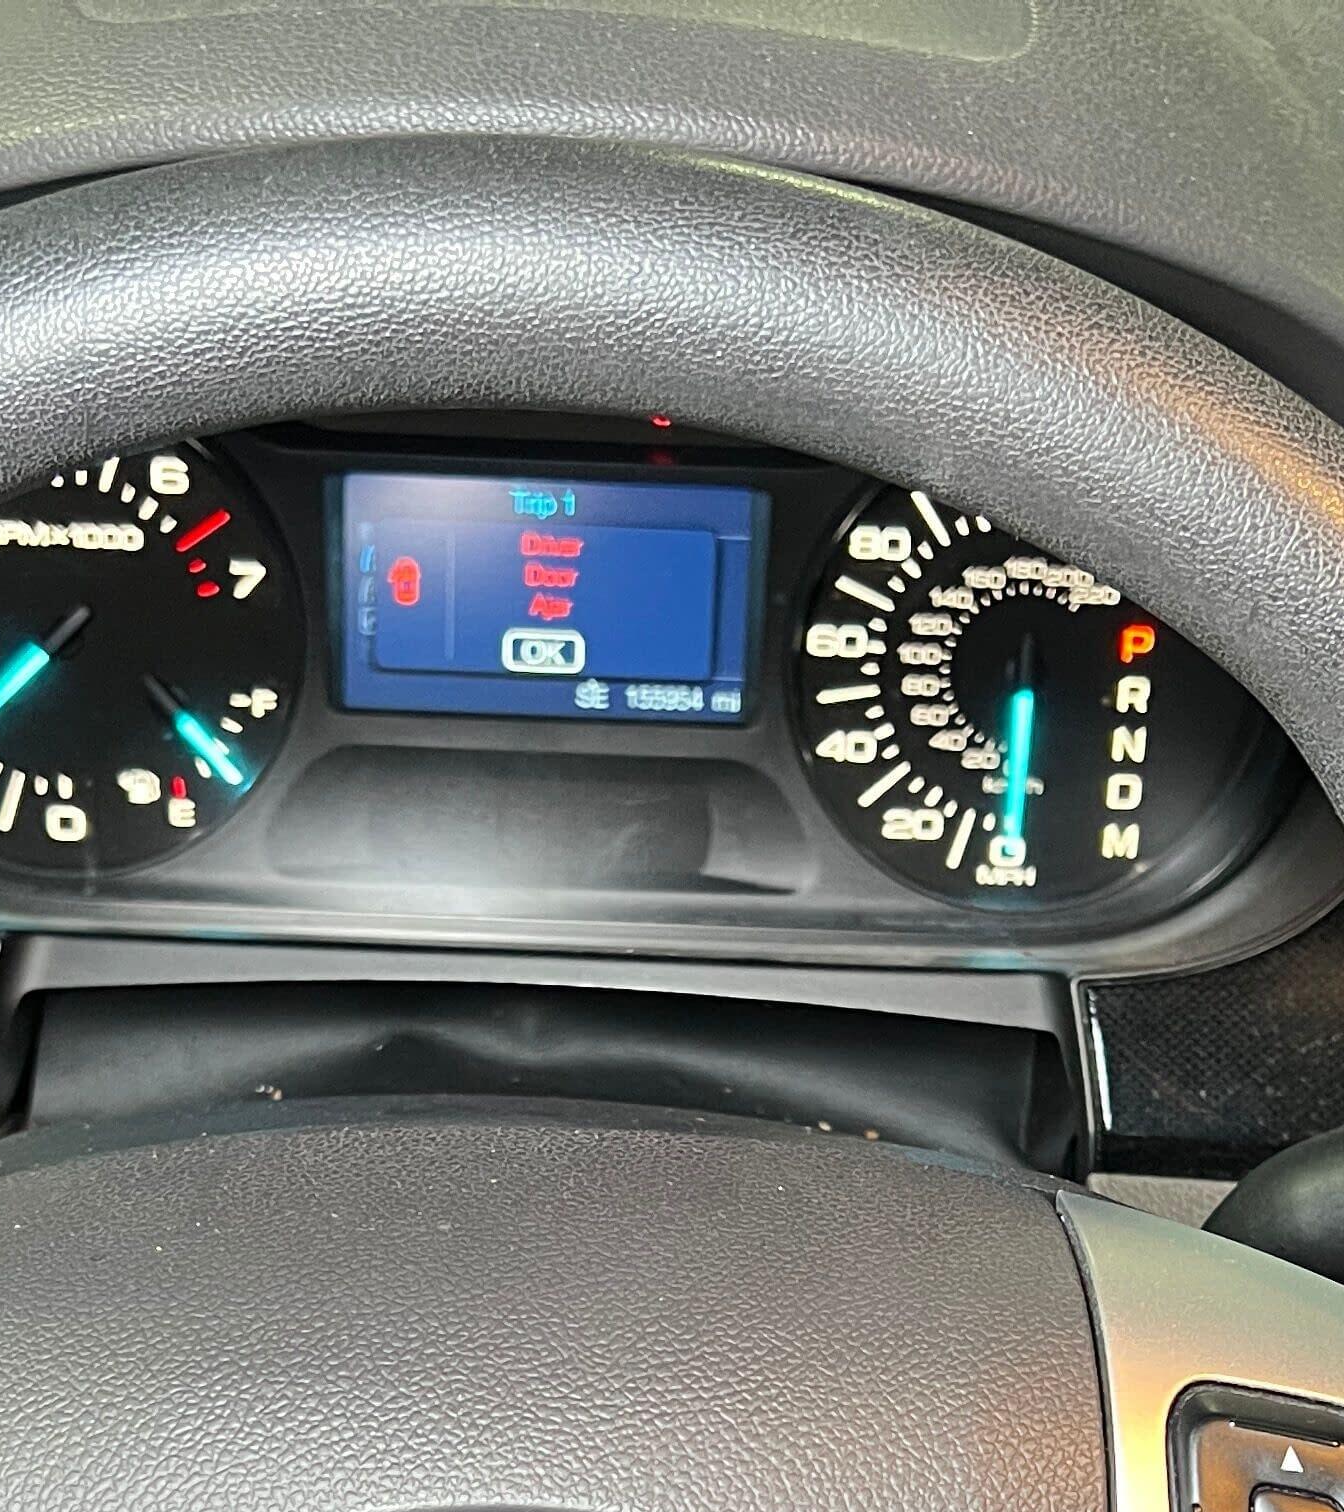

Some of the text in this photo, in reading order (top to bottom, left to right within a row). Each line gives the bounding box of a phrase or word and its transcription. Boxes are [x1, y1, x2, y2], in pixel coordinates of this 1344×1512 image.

[150, 455, 190, 495] 6
[508, 486, 576, 519] Trip 1
[849, 525, 911, 561] 80
[229, 558, 267, 600] 7
[962, 566, 1006, 590] 160
[1042, 564, 1095, 588] 200
[928, 585, 974, 609] 140
[1068, 583, 1121, 606] 220
[908, 612, 953, 636] 120
[520, 638, 567, 667] OK
[806, 623, 869, 658] 60
[897, 641, 943, 665] 100
[1117, 624, 1156, 663] P
[901, 673, 940, 697] 80
[1115, 675, 1151, 714] R
[250, 688, 278, 718] F
[910, 703, 950, 727] 60
[815, 730, 878, 763] 40
[928, 728, 968, 752] 40
[1111, 726, 1148, 763] N
[961, 747, 1001, 769] 20
[45, 804, 87, 842] 0
[168, 797, 197, 828] E
[882, 808, 945, 841] 20
[989, 834, 1026, 867] 0
[1101, 822, 1140, 860] M
